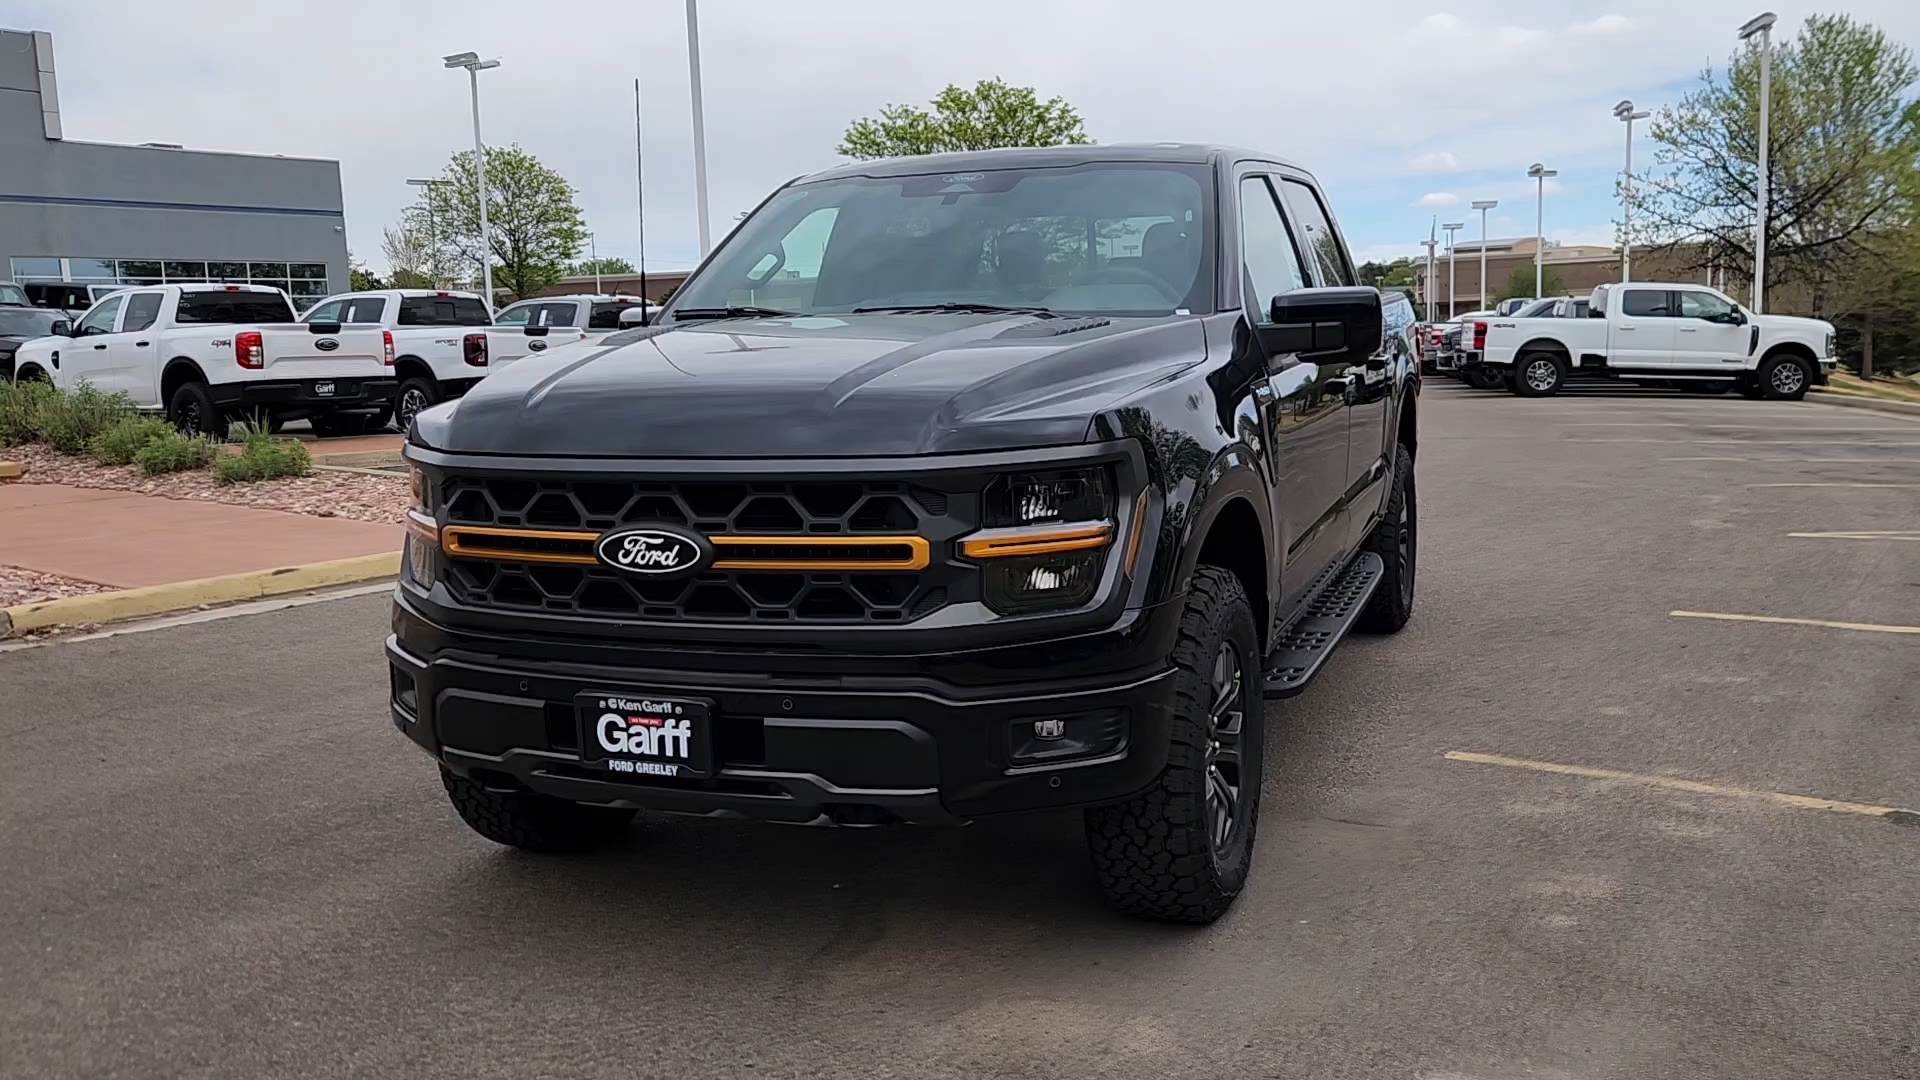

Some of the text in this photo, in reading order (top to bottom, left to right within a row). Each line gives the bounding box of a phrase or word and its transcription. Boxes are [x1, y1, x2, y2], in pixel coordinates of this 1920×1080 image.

[618, 536, 680, 566] Ford
[617, 698, 672, 714] Ken Garff
[597, 713, 691, 758] Garff
[609, 759, 678, 776] FORD GREELEY
